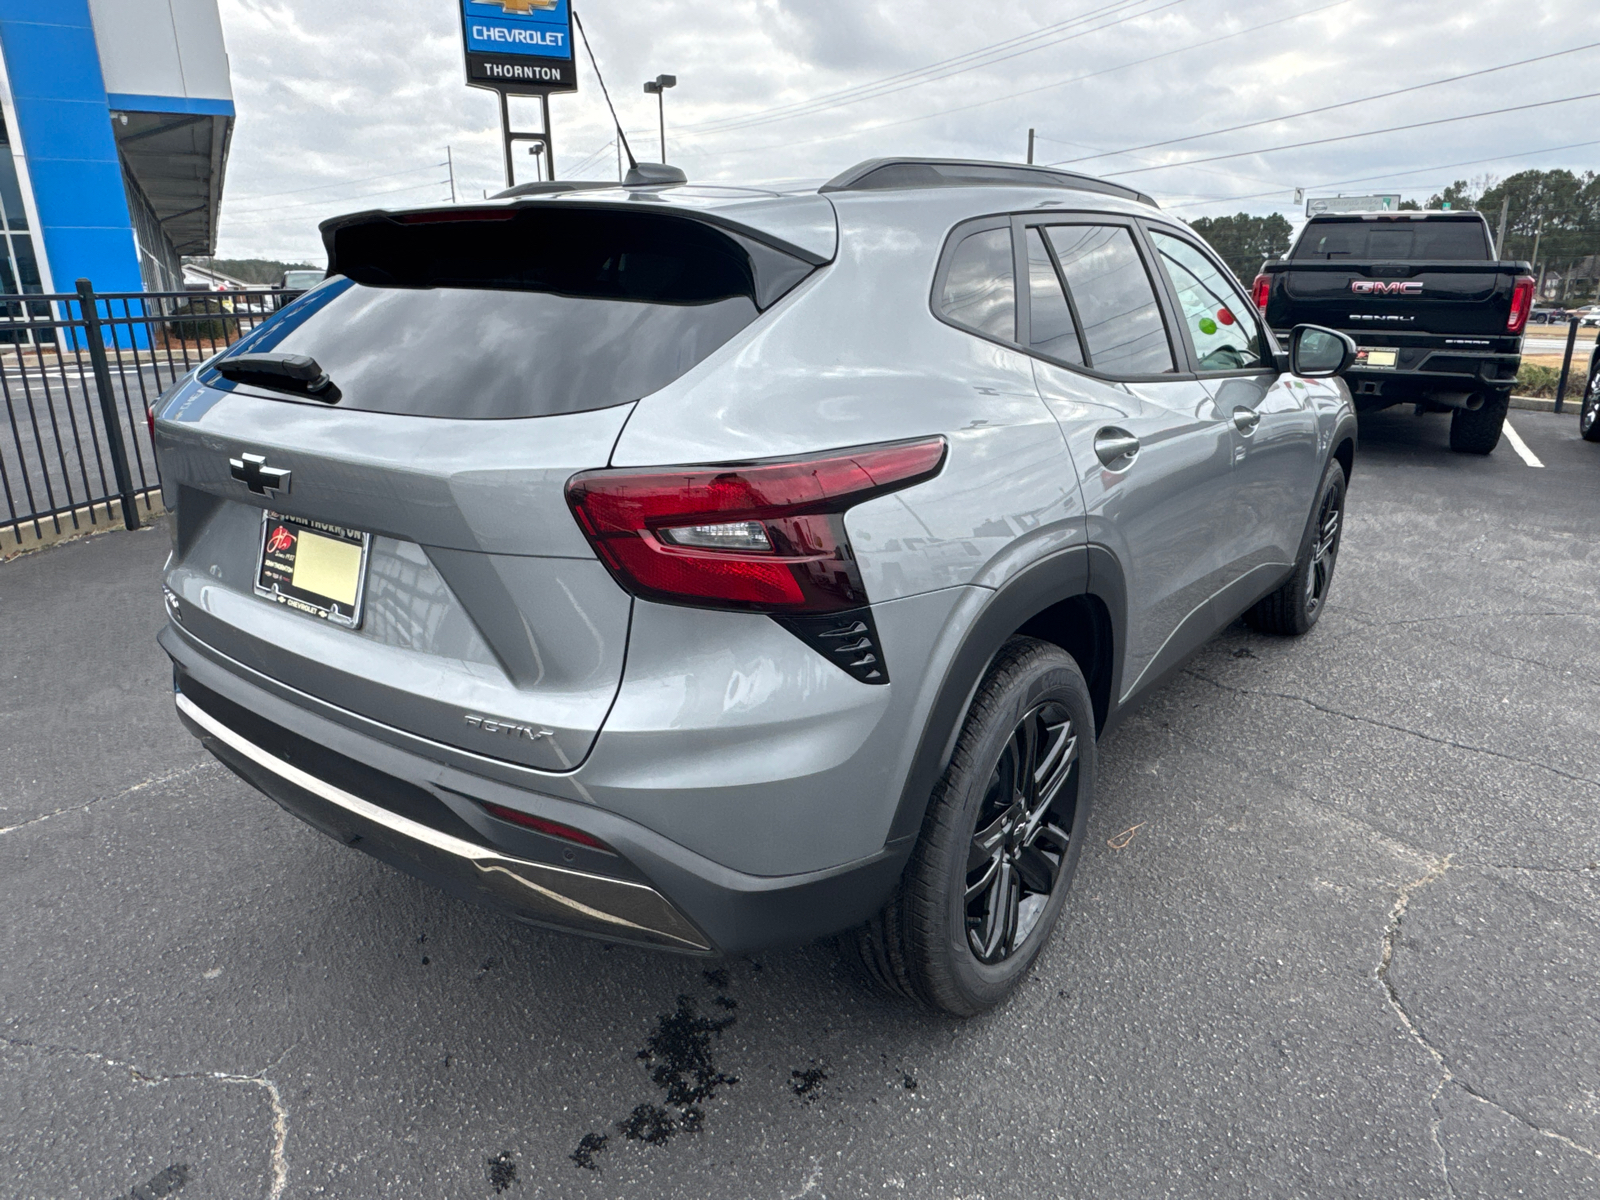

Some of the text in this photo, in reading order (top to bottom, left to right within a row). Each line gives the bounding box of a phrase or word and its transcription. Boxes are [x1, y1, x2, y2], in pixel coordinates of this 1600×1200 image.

[472, 25, 565, 47] CHEVROLET
[484, 63, 561, 81] THORNTON
[1352, 281, 1424, 295] GMC
[287, 599, 318, 615] CHEVROLET
